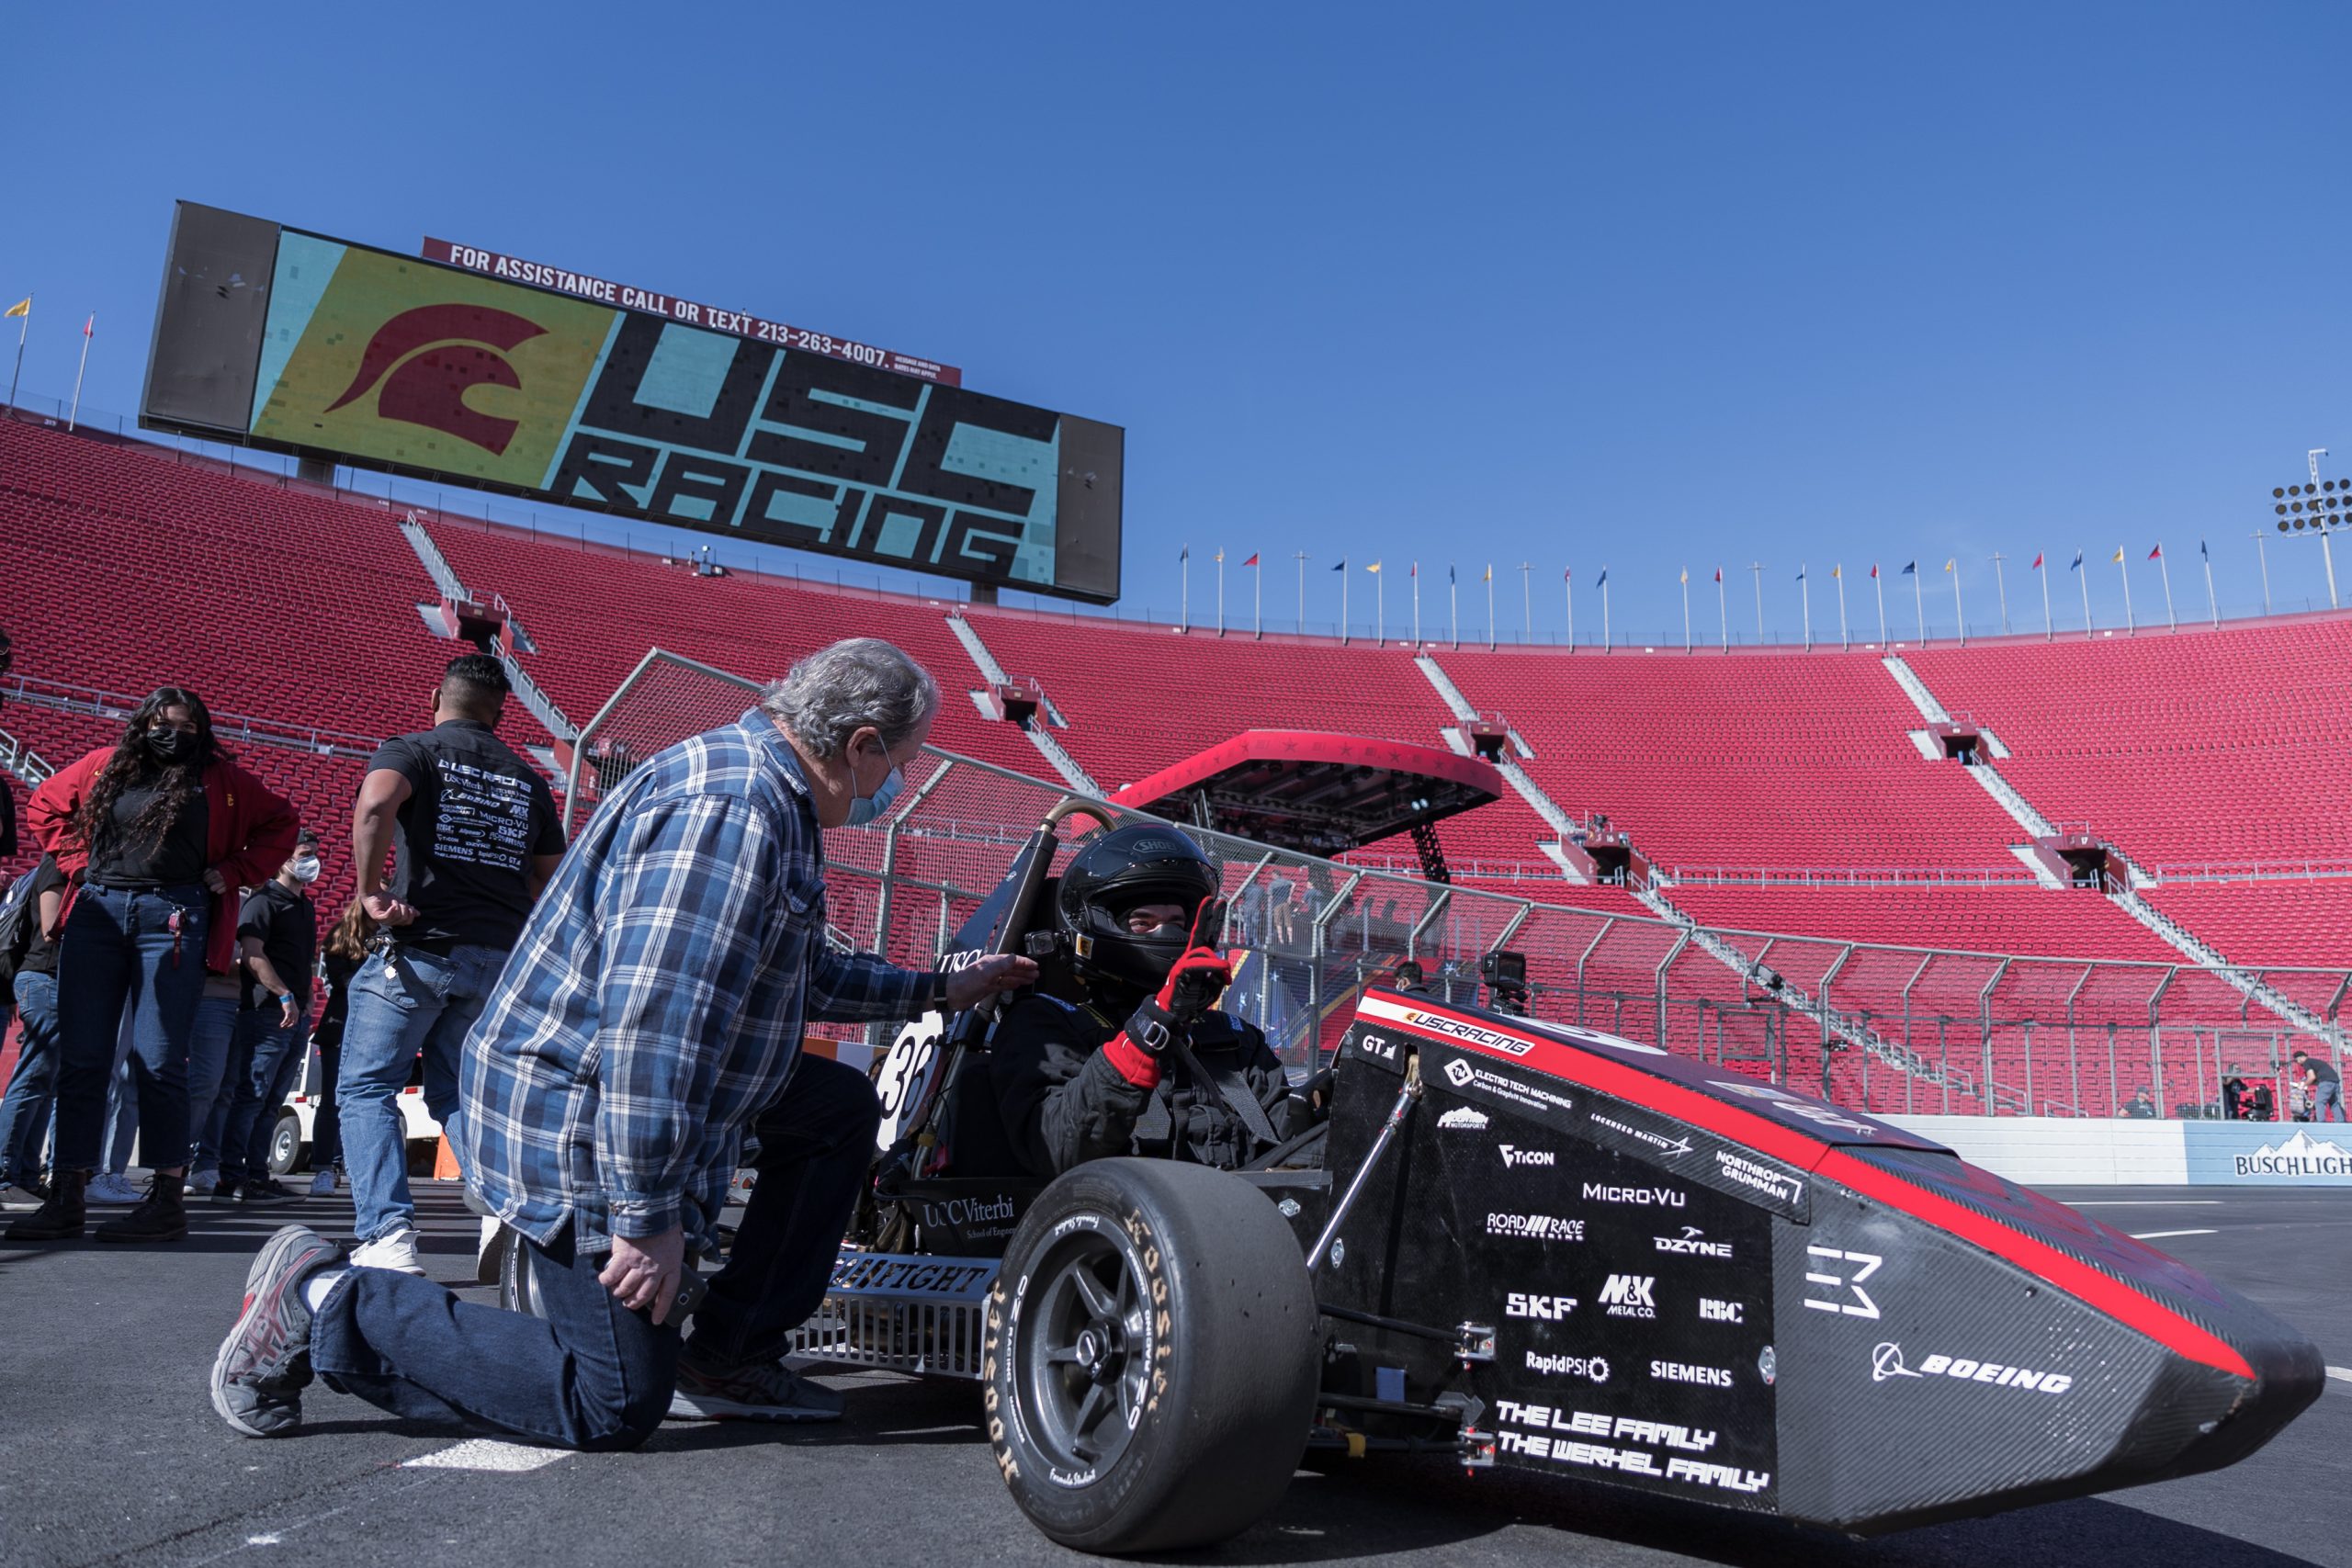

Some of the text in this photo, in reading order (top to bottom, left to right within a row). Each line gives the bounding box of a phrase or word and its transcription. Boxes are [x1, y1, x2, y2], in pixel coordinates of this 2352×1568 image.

[450, 244, 889, 368] FOR ASSISTANCE CALL OR TEXT 213-263-4007.
[435, 843, 474, 855] SIEMENS
[881, 1035, 936, 1121] 36
[1473, 1079, 1492, 1092] Carbon
[1475, 1068, 1572, 1109] ELECTRO TECH MACHINING
[1590, 1112, 1669, 1149] LOCKHEED MARTIN
[1716, 1150, 1781, 1183] NORTHROP
[1722, 1165, 1788, 1200] GRUMMAN
[962, 1193, 1014, 1223] Viterbi
[1487, 1213, 1586, 1235] ROAD RACE
[1653, 1236, 1733, 1258] DZYNE
[874, 1261, 989, 1292] FIGHT
[1598, 1274, 1656, 1307] M&K
[1506, 1292, 1578, 1320] SKF
[1607, 1304, 1657, 1319] METAL CO.
[1144, 1309, 1152, 1372] RACING
[1650, 1360, 1734, 1387] SIEMENS
[1919, 1354, 2074, 1393] BOEING
[1496, 1400, 1716, 1451] THE LEE FAMILY
[1498, 1430, 1551, 1457] THE
[1666, 1457, 1770, 1493] FAMILY
